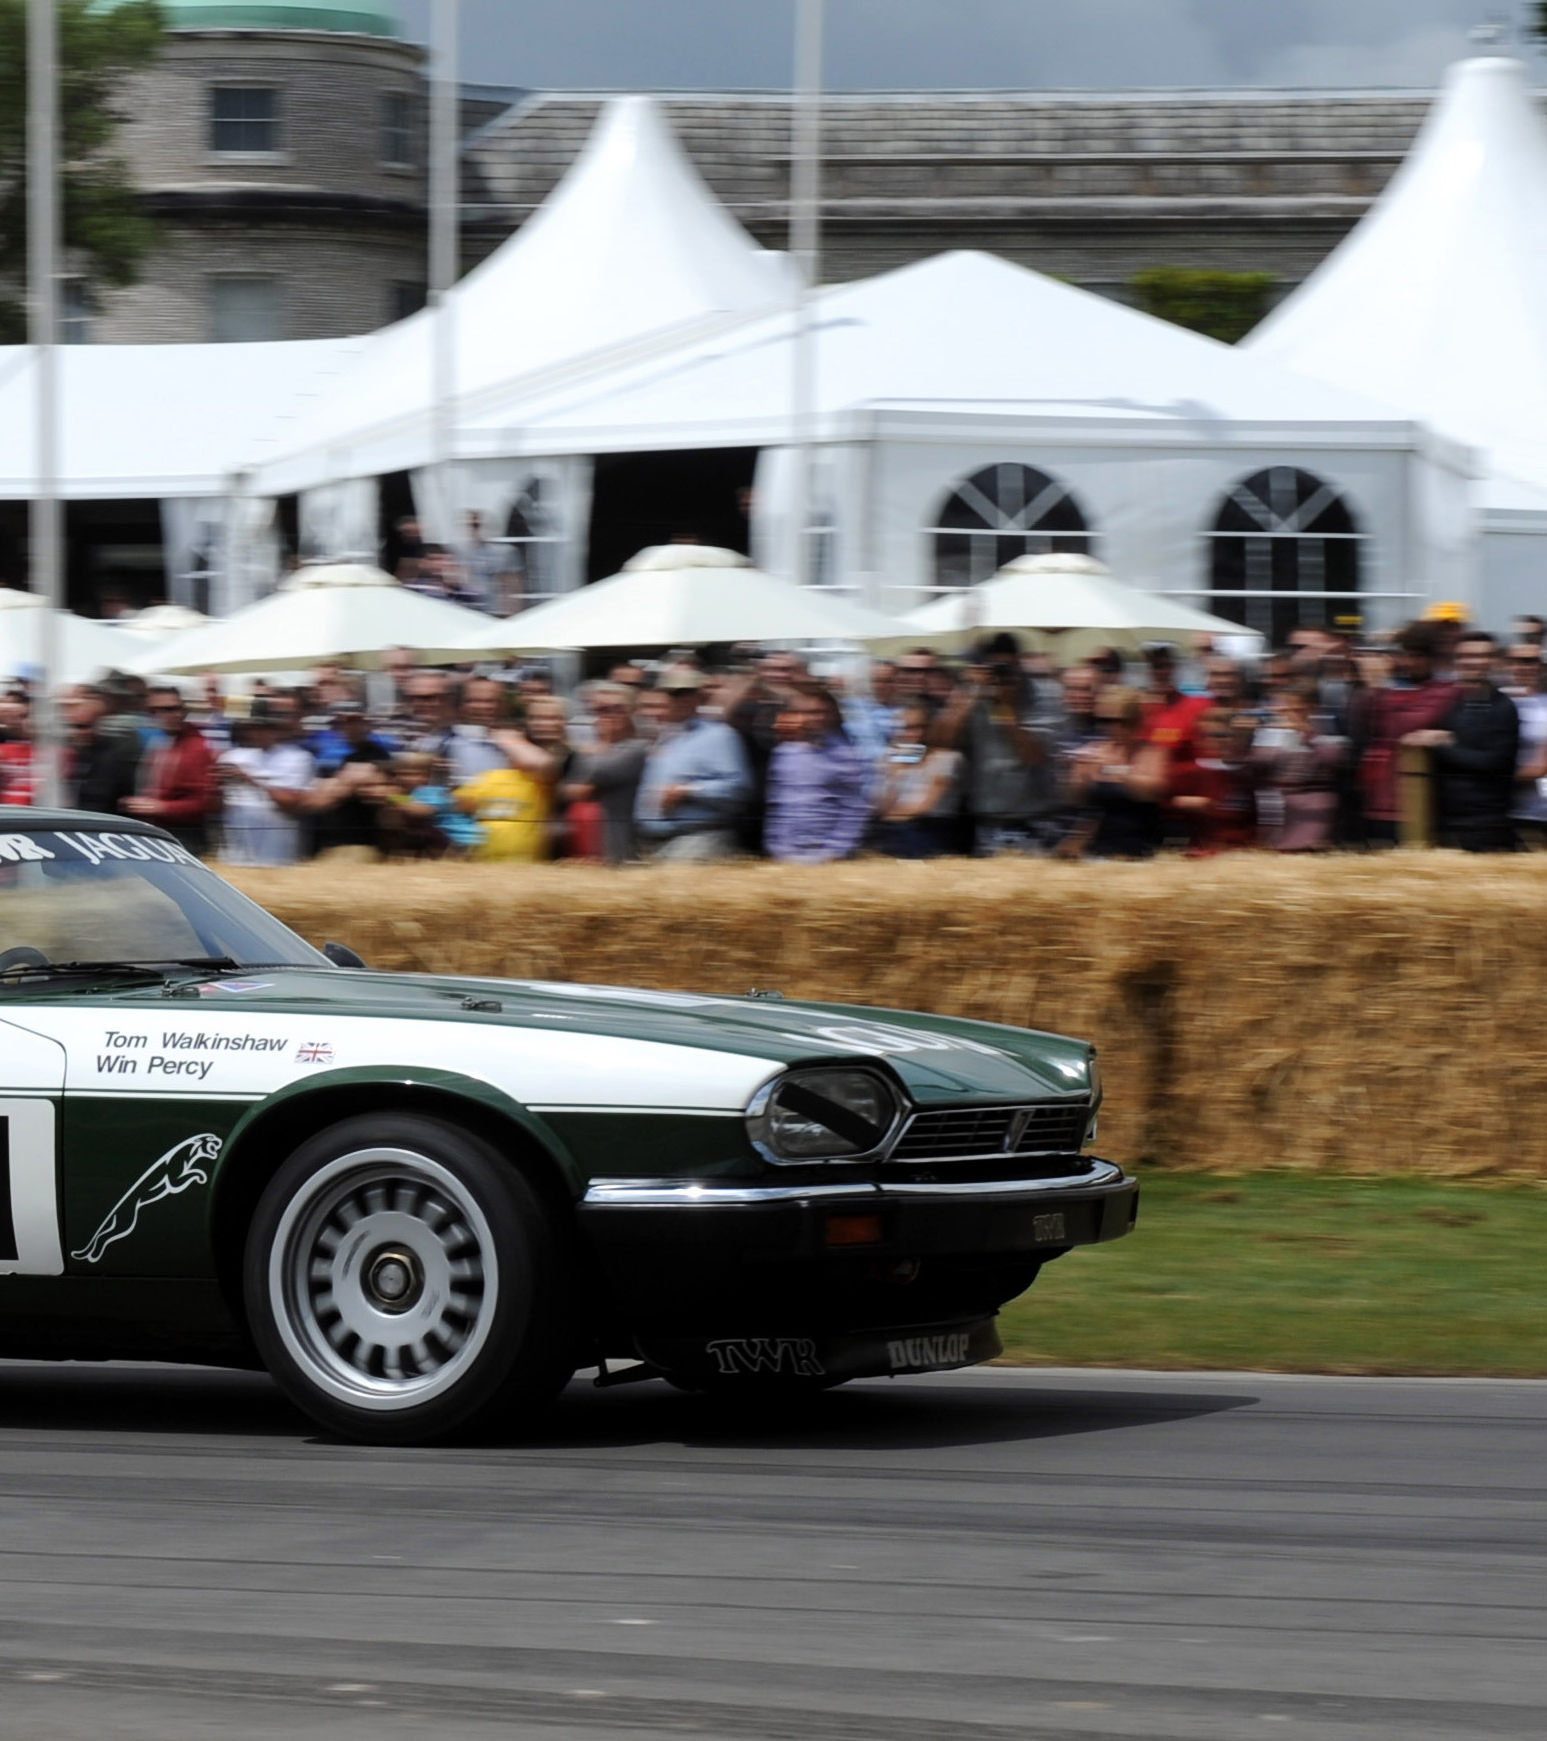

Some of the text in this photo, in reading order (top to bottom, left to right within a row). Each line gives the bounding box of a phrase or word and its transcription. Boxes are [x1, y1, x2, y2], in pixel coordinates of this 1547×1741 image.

[53, 831, 207, 866] JAGUA
[104, 1031, 288, 1053] Tom Walkinshaw
[95, 1055, 215, 1080] Win Percy
[706, 1338, 827, 1376] TWR
[887, 1334, 970, 1369] DUNLOP
